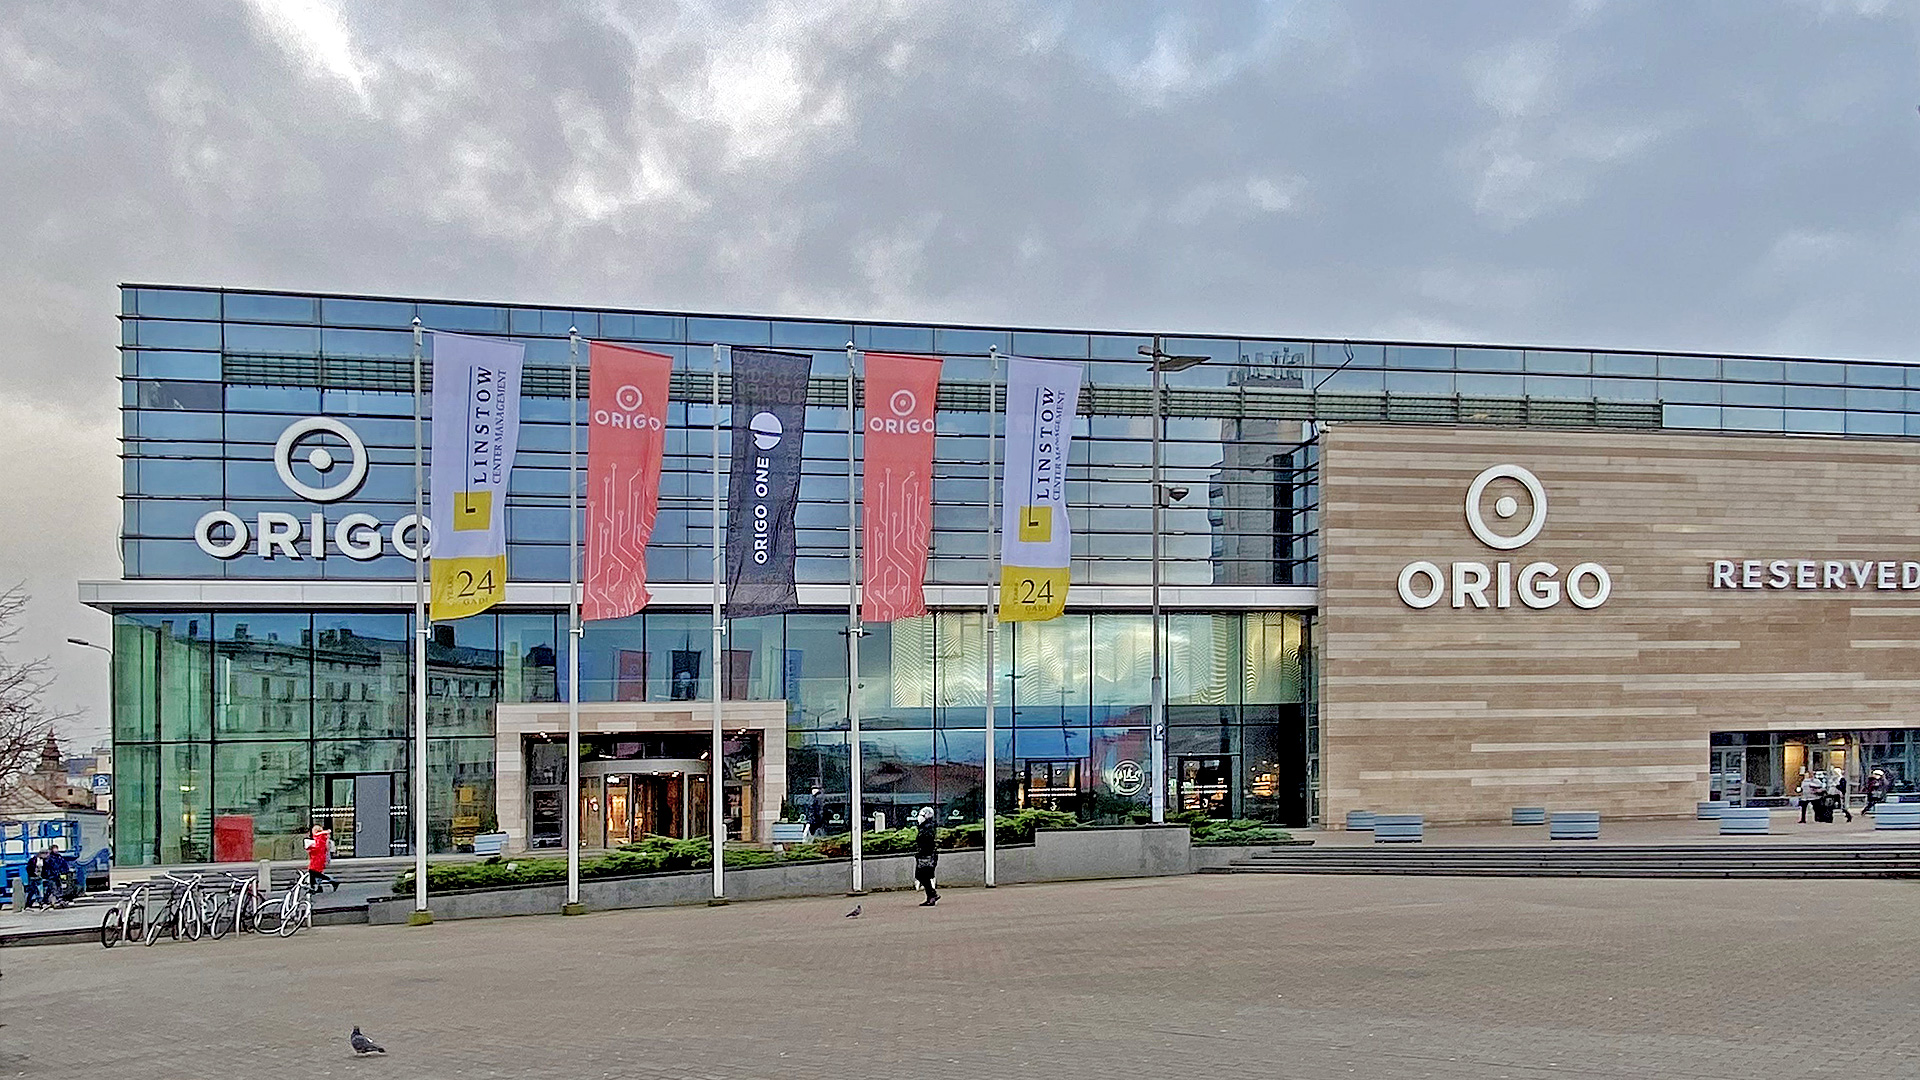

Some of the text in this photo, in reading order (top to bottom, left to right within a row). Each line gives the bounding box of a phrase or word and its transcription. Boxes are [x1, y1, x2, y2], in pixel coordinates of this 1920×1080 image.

[473, 366, 492, 484] LINSTOW
[492, 369, 507, 484] CENTER MANAGEMENT
[594, 409, 662, 432] ORIGO
[869, 416, 934, 434] ORIGO
[1036, 387, 1054, 500] LINSTOW
[1052, 463, 1062, 501] CENTER
[753, 456, 769, 565] ORIGO ONE
[194, 510, 432, 560] ORIGO
[457, 570, 496, 598] 24
[1020, 579, 1054, 604] 24
[1397, 561, 1612, 610] ORIGO
[1713, 559, 1920, 589] RESERVED
